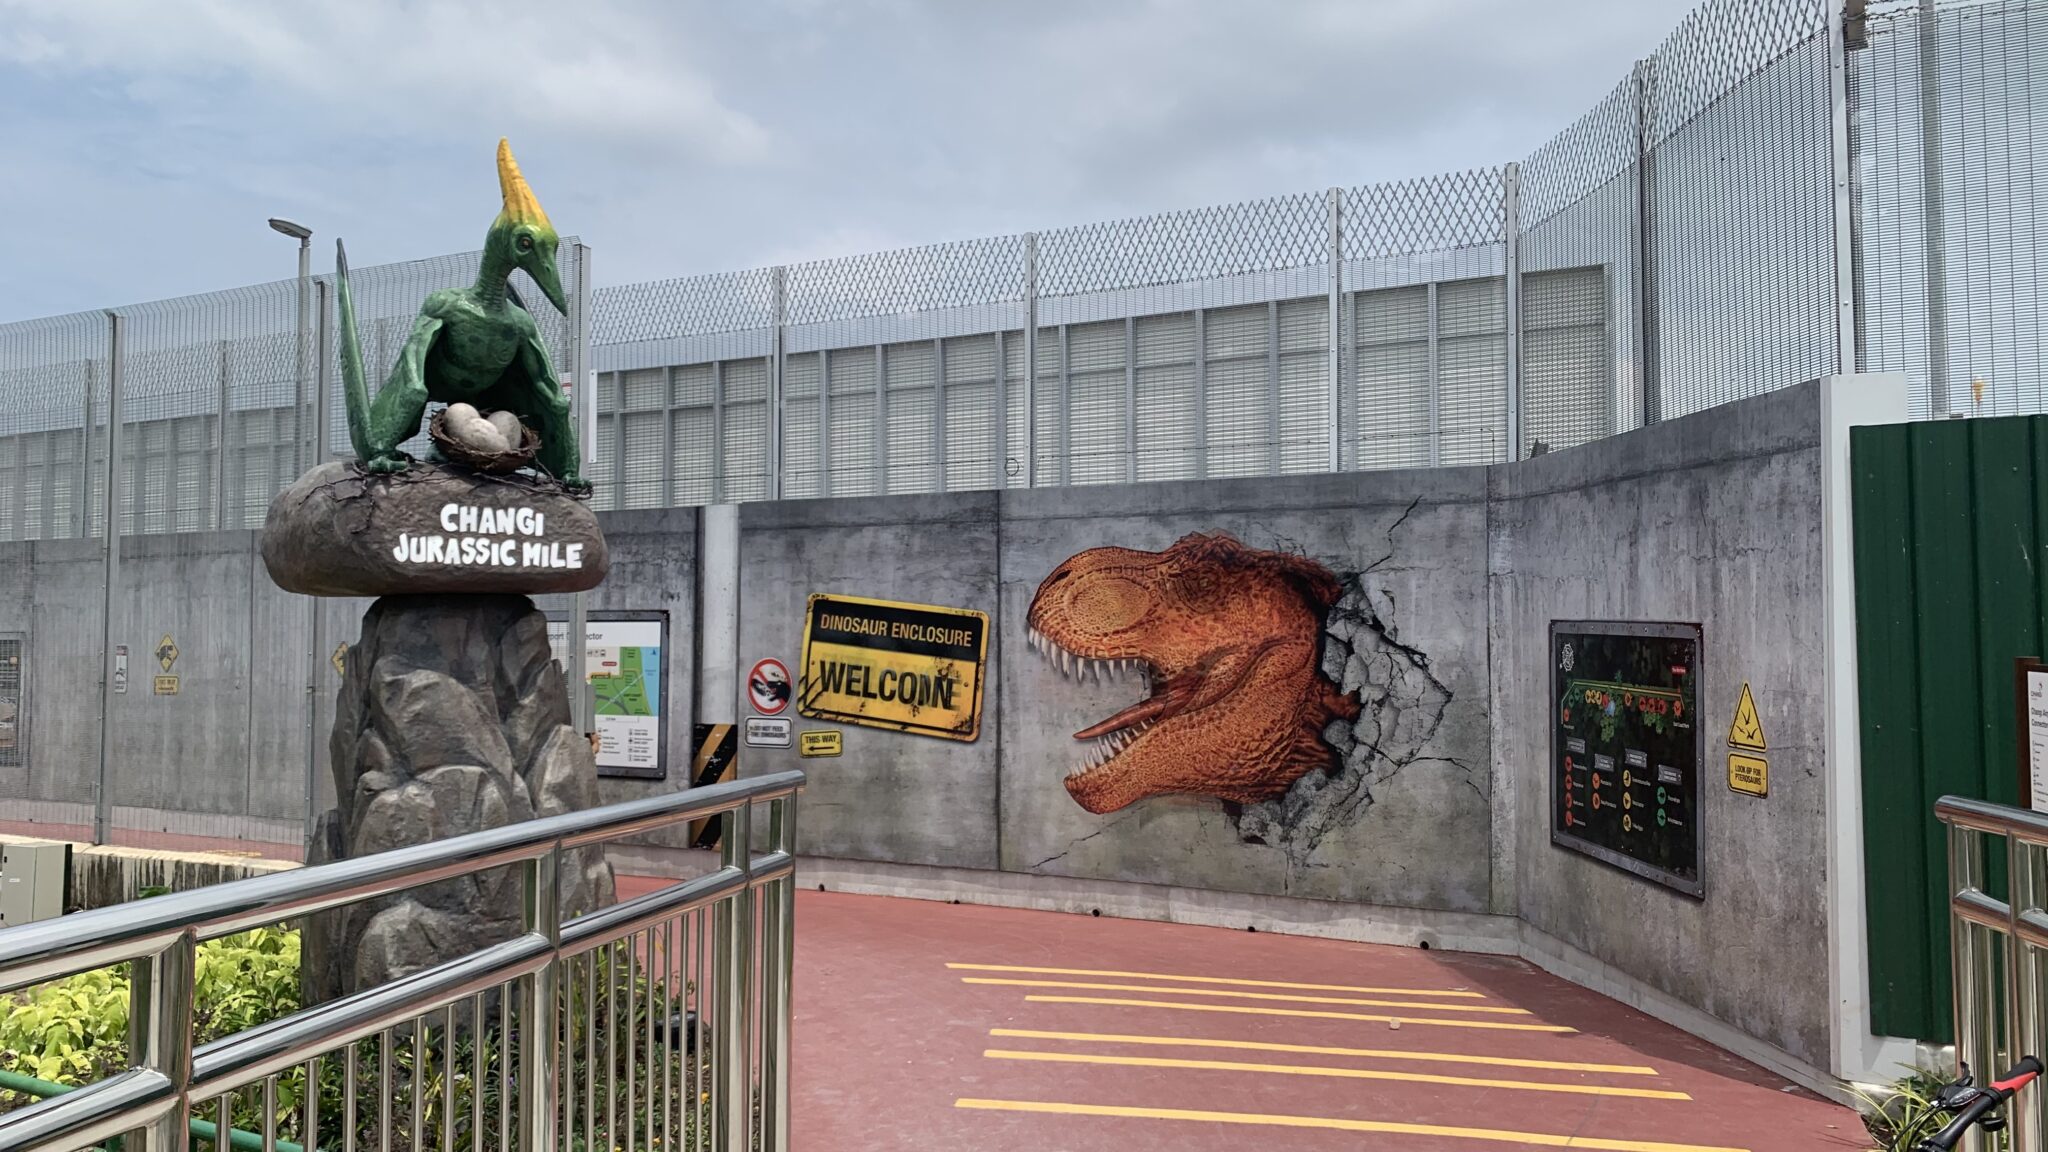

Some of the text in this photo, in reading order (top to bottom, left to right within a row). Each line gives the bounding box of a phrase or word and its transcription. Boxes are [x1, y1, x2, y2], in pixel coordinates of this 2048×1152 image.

[440, 503, 544, 537] CHANGI
[392, 533, 584, 569] JURASSIC MILE
[820, 613, 973, 647] DINOSAUR ENCLOSURE
[805, 734, 837, 744] THIS WAY
[1735, 773, 1761, 785] PTEROSAURS
